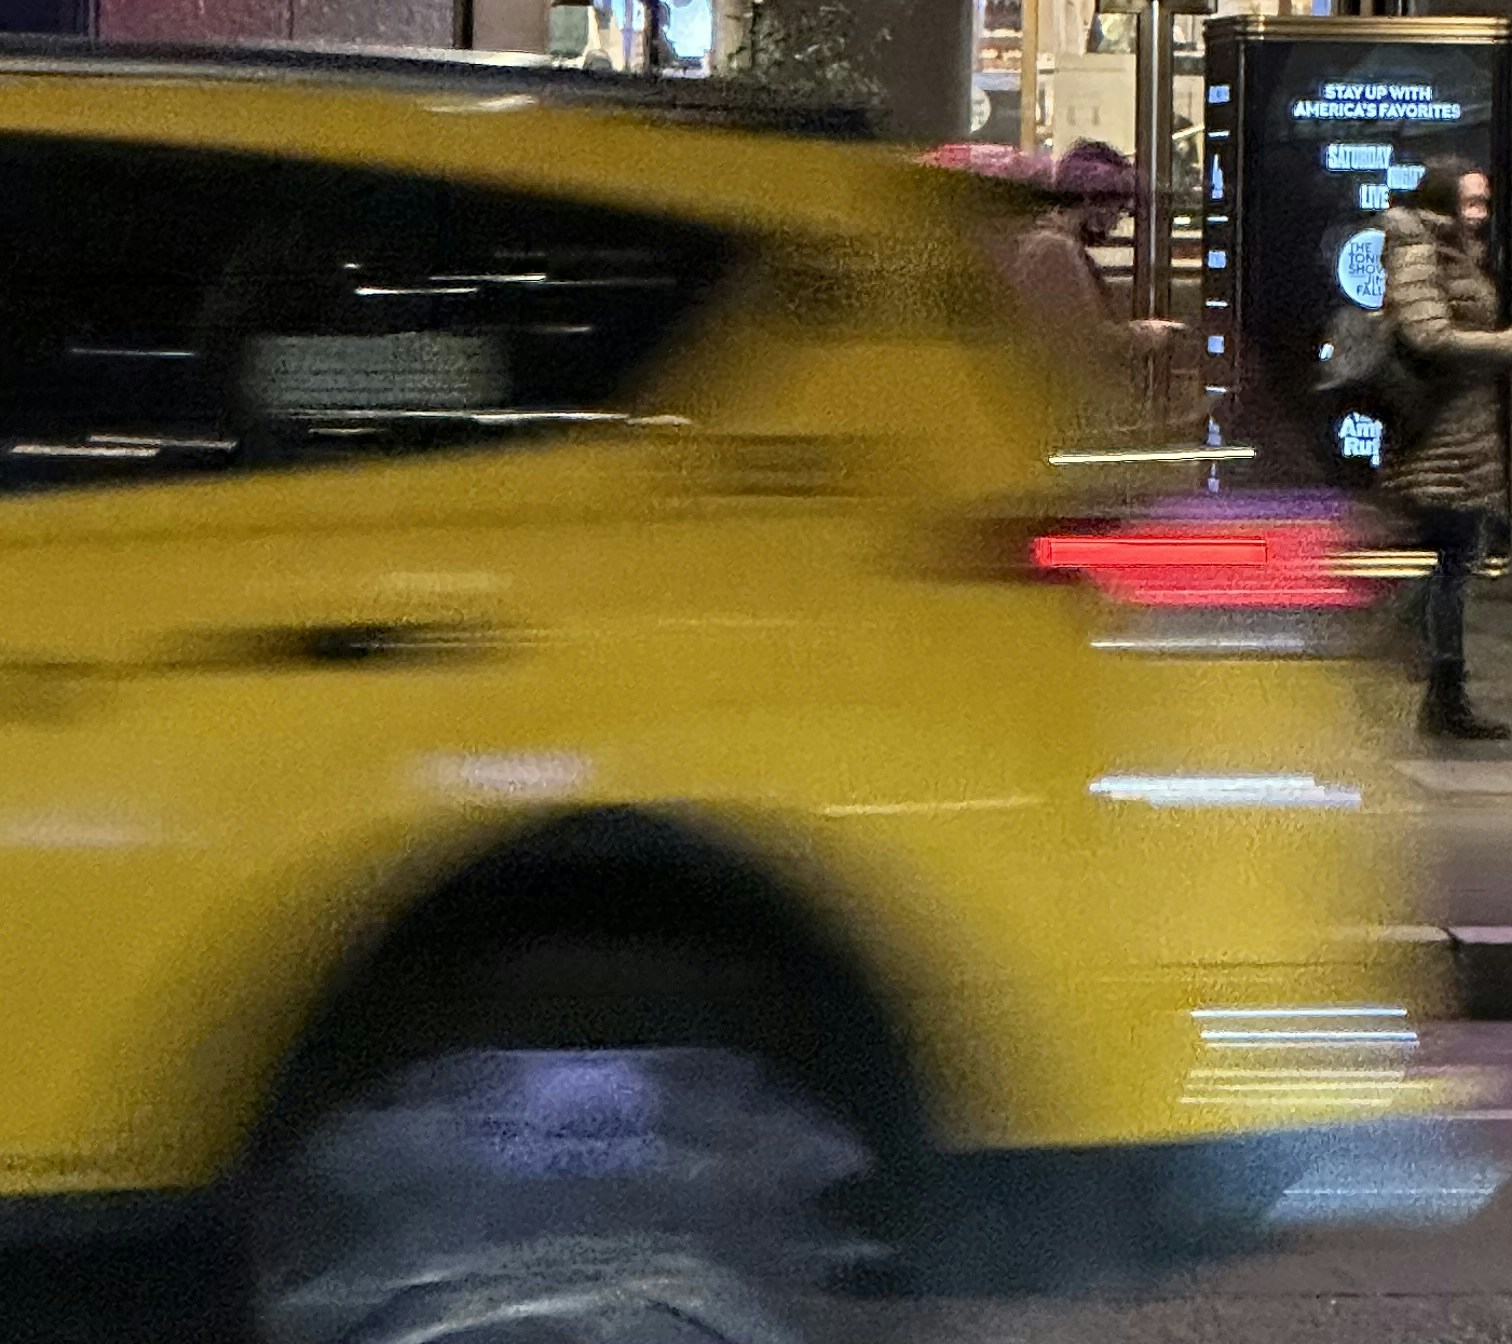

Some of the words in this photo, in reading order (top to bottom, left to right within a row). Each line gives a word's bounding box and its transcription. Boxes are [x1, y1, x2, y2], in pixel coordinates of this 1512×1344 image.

[1324, 83, 1363, 100] STAY
[1365, 84, 1388, 100] UP
[1390, 85, 1432, 101] WITH
[1294, 101, 1378, 118] AMERICA'S
[1379, 103, 1461, 119] FAVORITES
[1328, 144, 1393, 170] SATURDAY
[1361, 185, 1390, 209] LIVE
[1350, 242, 1372, 253] THE
[1348, 253, 1380, 265] TONI
[1356, 284, 1382, 296] FALL
